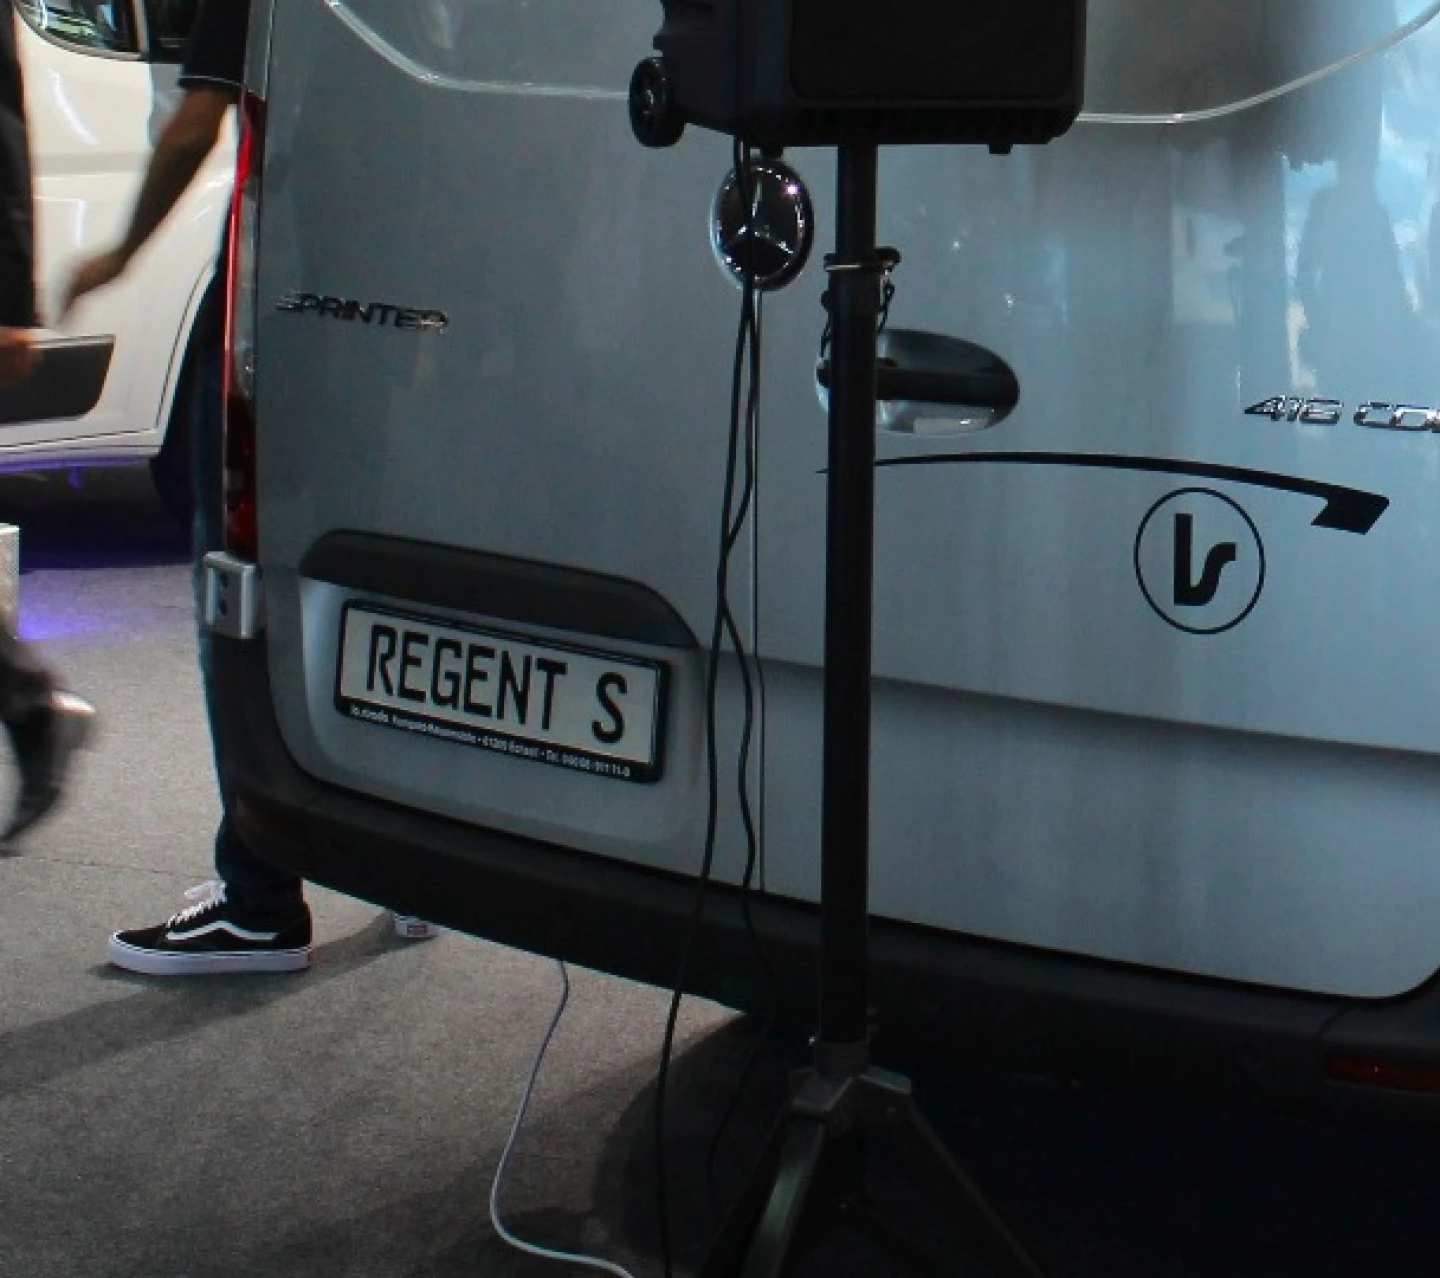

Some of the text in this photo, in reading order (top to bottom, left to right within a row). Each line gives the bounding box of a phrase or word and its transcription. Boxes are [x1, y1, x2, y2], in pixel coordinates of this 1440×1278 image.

[276, 291, 449, 334] SPRINTER
[366, 624, 567, 731] REGENT
[591, 672, 629, 744] S
